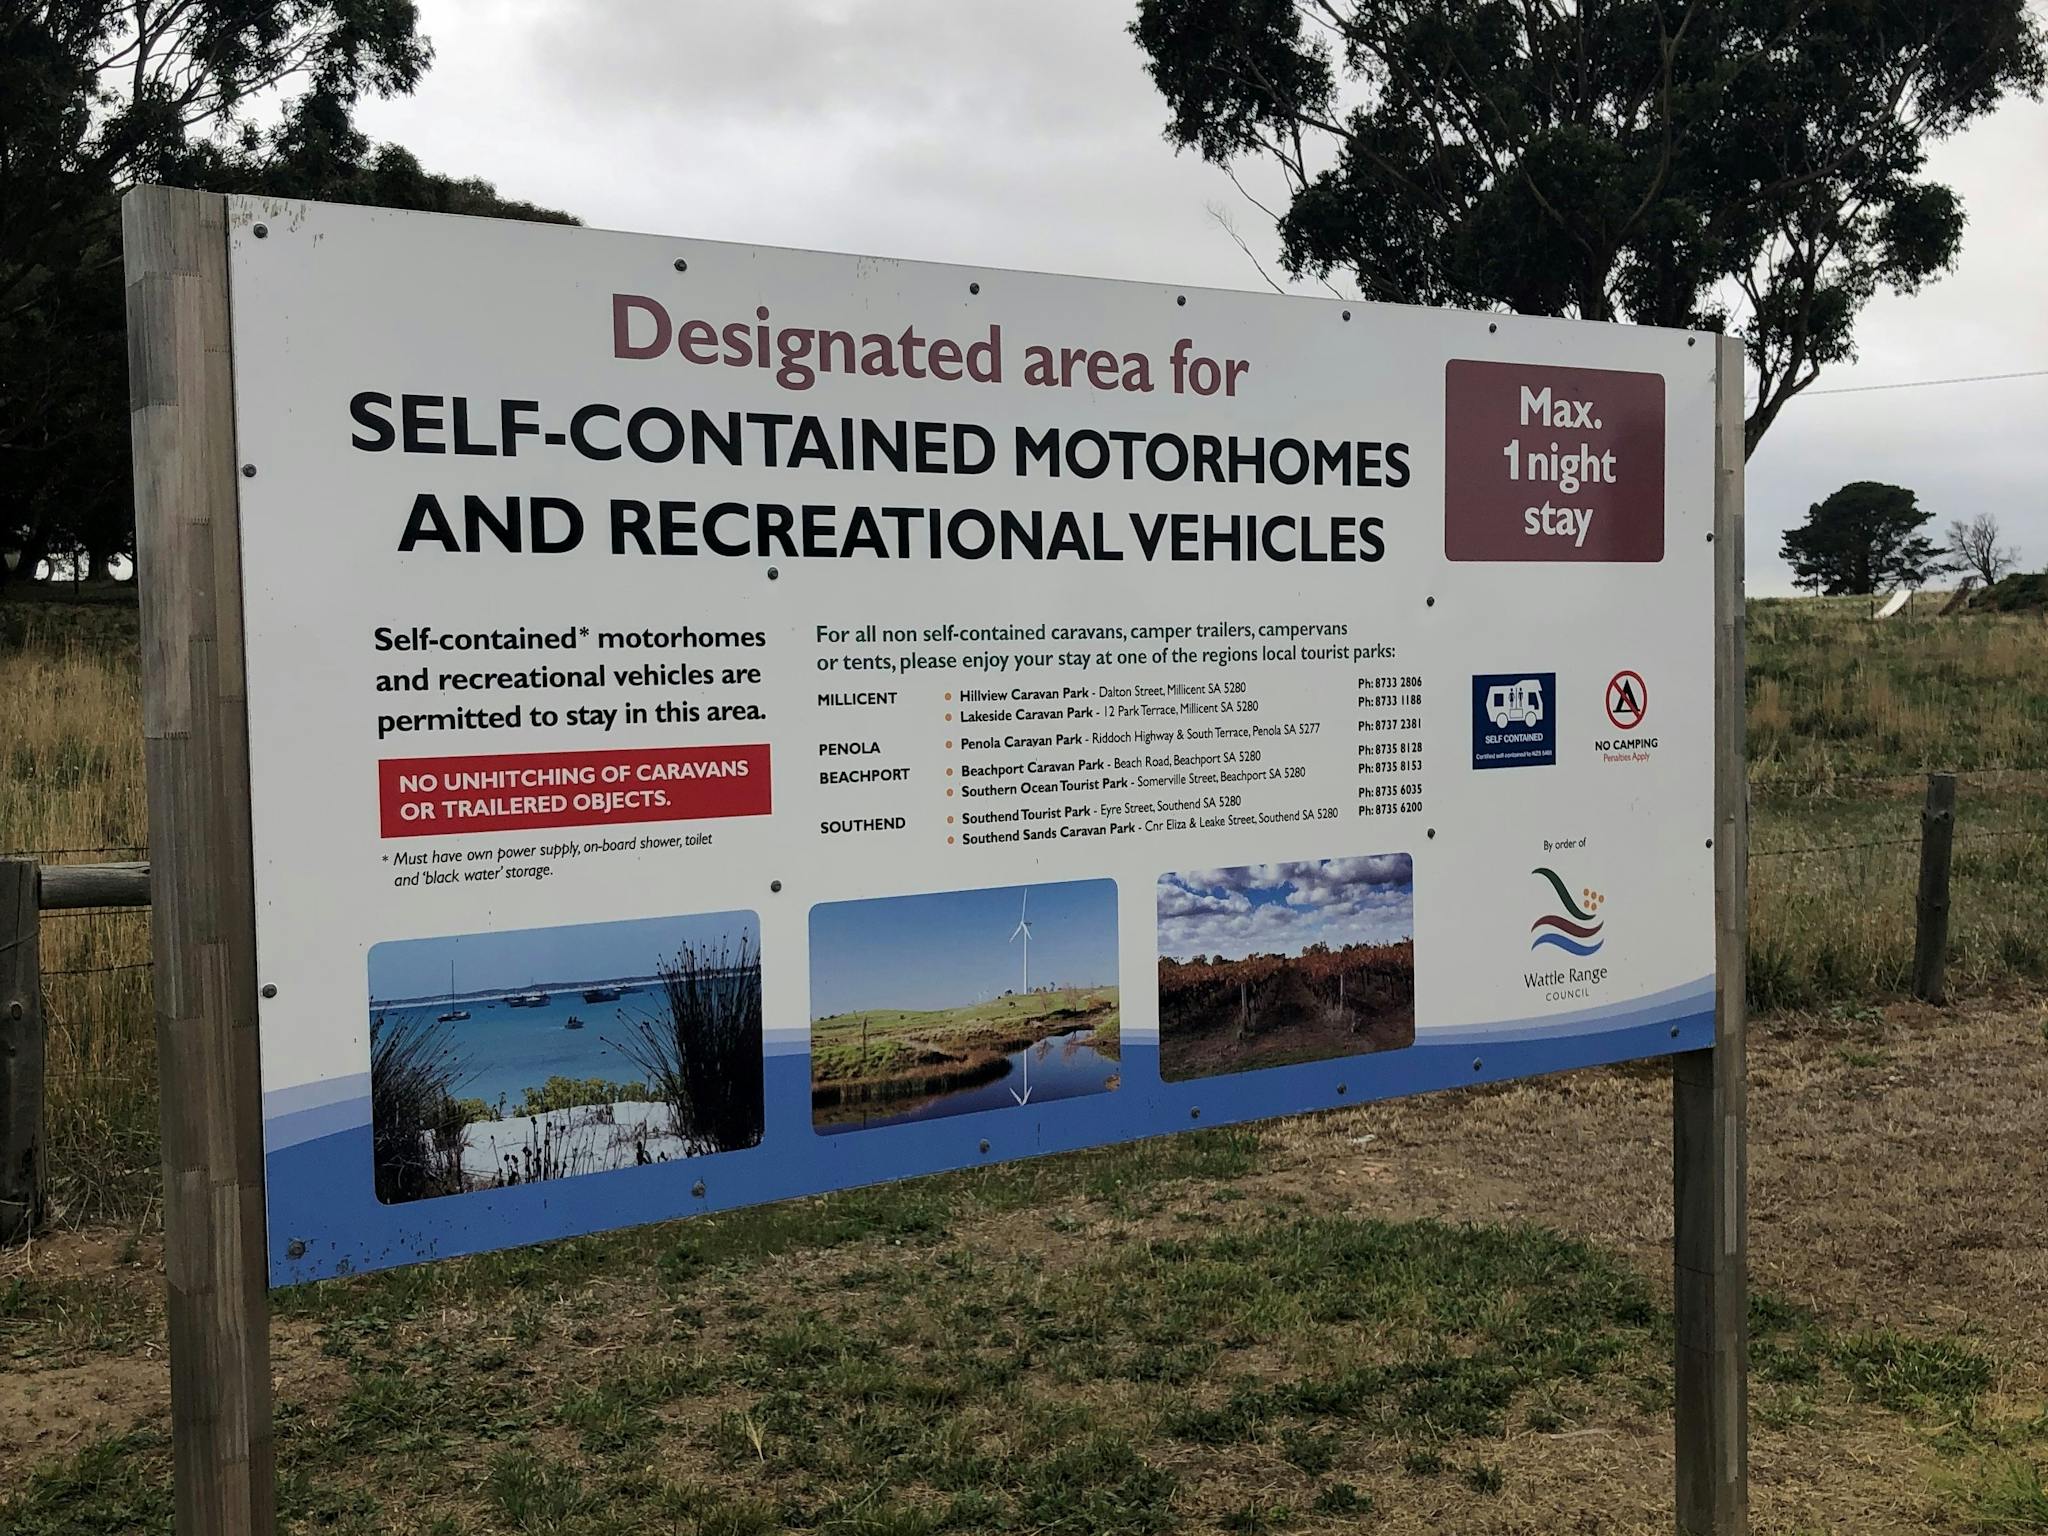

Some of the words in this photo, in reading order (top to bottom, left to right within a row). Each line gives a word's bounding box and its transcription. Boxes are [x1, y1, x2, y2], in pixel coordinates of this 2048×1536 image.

[613, 294, 1001, 390] Designated
[1024, 346, 1154, 392] area
[1170, 339, 1249, 396] for
[1521, 386, 1602, 429] Max.
[350, 392, 995, 474] SELF-CONTAINED
[1016, 427, 1410, 487] MOTORHOMES
[1504, 440, 1519, 479] 1
[1529, 442, 1616, 493] night
[398, 494, 583, 553] AND
[610, 499, 1123, 560] RECREATIONAL
[1129, 513, 1384, 562] VEHICLES
[1525, 501, 1593, 547] stay
[599, 626, 765, 648] motorhomes
[817, 626, 849, 642] For
[856, 625, 876, 642] all
[883, 630, 916, 642] non
[924, 624, 1045, 641] self-contained
[1052, 628, 1127, 641] caravans,
[1131, 624, 1199, 643] camper
[1197, 622, 1255, 640] trailers,
[1259, 625, 1347, 640] campervans
[817, 659, 838, 670] or
[843, 656, 896, 672] tents,
[901, 652, 956, 674] please
[963, 651, 1009, 672] enjoy
[1014, 655, 1053, 671] your
[1059, 652, 1090, 669] stay
[1096, 651, 1112, 664] at
[1118, 653, 1146, 664] one
[1152, 648, 1168, 663] of
[1172, 648, 1197, 662] the
[1203, 647, 1257, 666] regions
[1263, 645, 1295, 660] local
[1301, 645, 1349, 659] tourist
[1354, 643, 1395, 663] parks:
[377, 668, 428, 691] and
[440, 665, 605, 690] recreational
[614, 663, 713, 686] vehicles
[722, 669, 760, 684] are
[1359, 679, 1373, 688] Ph:
[1376, 677, 1397, 688] 8733
[1401, 677, 1421, 687] 2806
[818, 692, 897, 706] MILLICENT
[961, 690, 1007, 701] Hillview
[1012, 689, 1058, 700] Caravan
[1063, 687, 1088, 698] Park
[1100, 687, 1131, 697] Dalton
[1135, 686, 1165, 696] Street,
[1168, 684, 1205, 695] Millicent
[1209, 683, 1221, 693] SA
[1224, 682, 1245, 693] 5280
[1359, 697, 1373, 707] Ph:
[1376, 696, 1397, 706] 8733
[1402, 695, 1421, 705] 1188
[378, 705, 521, 739] permitted
[530, 708, 558, 726] to
[567, 706, 617, 731] stay
[626, 702, 647, 723] in
[655, 701, 699, 722] this
[708, 705, 766, 721] area.
[961, 710, 1011, 722] Lakeside
[1016, 709, 1063, 720] Caravan
[1068, 707, 1093, 718] Park
[1105, 706, 1114, 716] 12
[1119, 705, 1139, 716] Park
[1141, 705, 1178, 715] Terrace,
[1181, 703, 1218, 714] Millicent
[1221, 702, 1233, 712] SA
[1237, 701, 1258, 712] 5280
[1359, 721, 1373, 731] Ph:
[1376, 720, 1397, 730] 8737
[1401, 718, 1420, 729] 2381
[1486, 735, 1502, 744] SELF
[1504, 733, 1543, 742] CONTAINED
[1596, 741, 1610, 751] NO
[1613, 738, 1657, 750] CAMPING
[820, 742, 880, 755] PENOLA
[1359, 745, 1373, 755] Ph:
[1376, 744, 1397, 754] 8735
[1401, 743, 1422, 753] 8128
[1604, 754, 1631, 762] Penalties
[1632, 752, 1649, 762] Apply
[962, 764, 1024, 778] Beachport
[1028, 762, 1074, 773] Caravan
[1079, 759, 1104, 770] Park
[1115, 757, 1141, 768] Beach
[1146, 756, 1171, 767] Road,
[1174, 754, 1220, 767] Beachport
[1224, 752, 1236, 762] SA
[1240, 751, 1261, 761] 5280
[1359, 763, 1373, 773] Ph:
[1376, 761, 1397, 772] 8735
[1401, 760, 1421, 771] 8153
[400, 775, 437, 793] NO
[445, 767, 595, 790] UNHITCHING
[602, 766, 630, 782] OF
[637, 760, 748, 781] CARAVANS
[820, 768, 910, 784] BEACHPORT
[962, 785, 1016, 797] Southern
[1021, 783, 1058, 793] Ocean
[1060, 779, 1099, 791] Tourist
[1103, 777, 1127, 788] Park
[1138, 774, 1186, 787] Somerville
[1189, 773, 1218, 783] Street,
[1221, 770, 1266, 781] Beachport
[1270, 769, 1281, 779] SA
[1285, 767, 1305, 778] 5280
[1359, 788, 1373, 797] Ph:
[1376, 785, 1397, 796] 8735
[1401, 784, 1422, 795] 6035
[401, 802, 435, 820] OR
[442, 795, 567, 818] TRAILERED
[573, 790, 671, 813] OBJECTS.
[963, 810, 1019, 824] Southend
[1021, 808, 1061, 820] Tourist
[1065, 806, 1090, 817] Park
[1101, 804, 1121, 818] Eyre
[1125, 803, 1155, 813] Street,
[1157, 798, 1200, 811] Southend
[1204, 798, 1216, 808] SA
[1220, 796, 1241, 807] 5280
[1359, 806, 1373, 816] Ph:
[1376, 804, 1397, 814] 8735
[1401, 802, 1422, 812] 6200
[821, 817, 905, 833] SOUTHEND
[394, 852, 427, 865] Must
[433, 850, 462, 863] have
[467, 851, 492, 860] own
[498, 848, 536, 862] power
[540, 841, 580, 859] supply,
[584, 837, 636, 852] on-board
[640, 836, 682, 848] shower,
[686, 833, 712, 845] toilet
[1544, 840, 1553, 852] By
[1555, 839, 1576, 849] order
[1579, 837, 1586, 847] of
[395, 872, 419, 886] and
[506, 867, 553, 880] storage.
[1524, 971, 1564, 988] Wattle
[1570, 969, 1607, 984] Range
[1546, 989, 1589, 1001] COUNCIL
